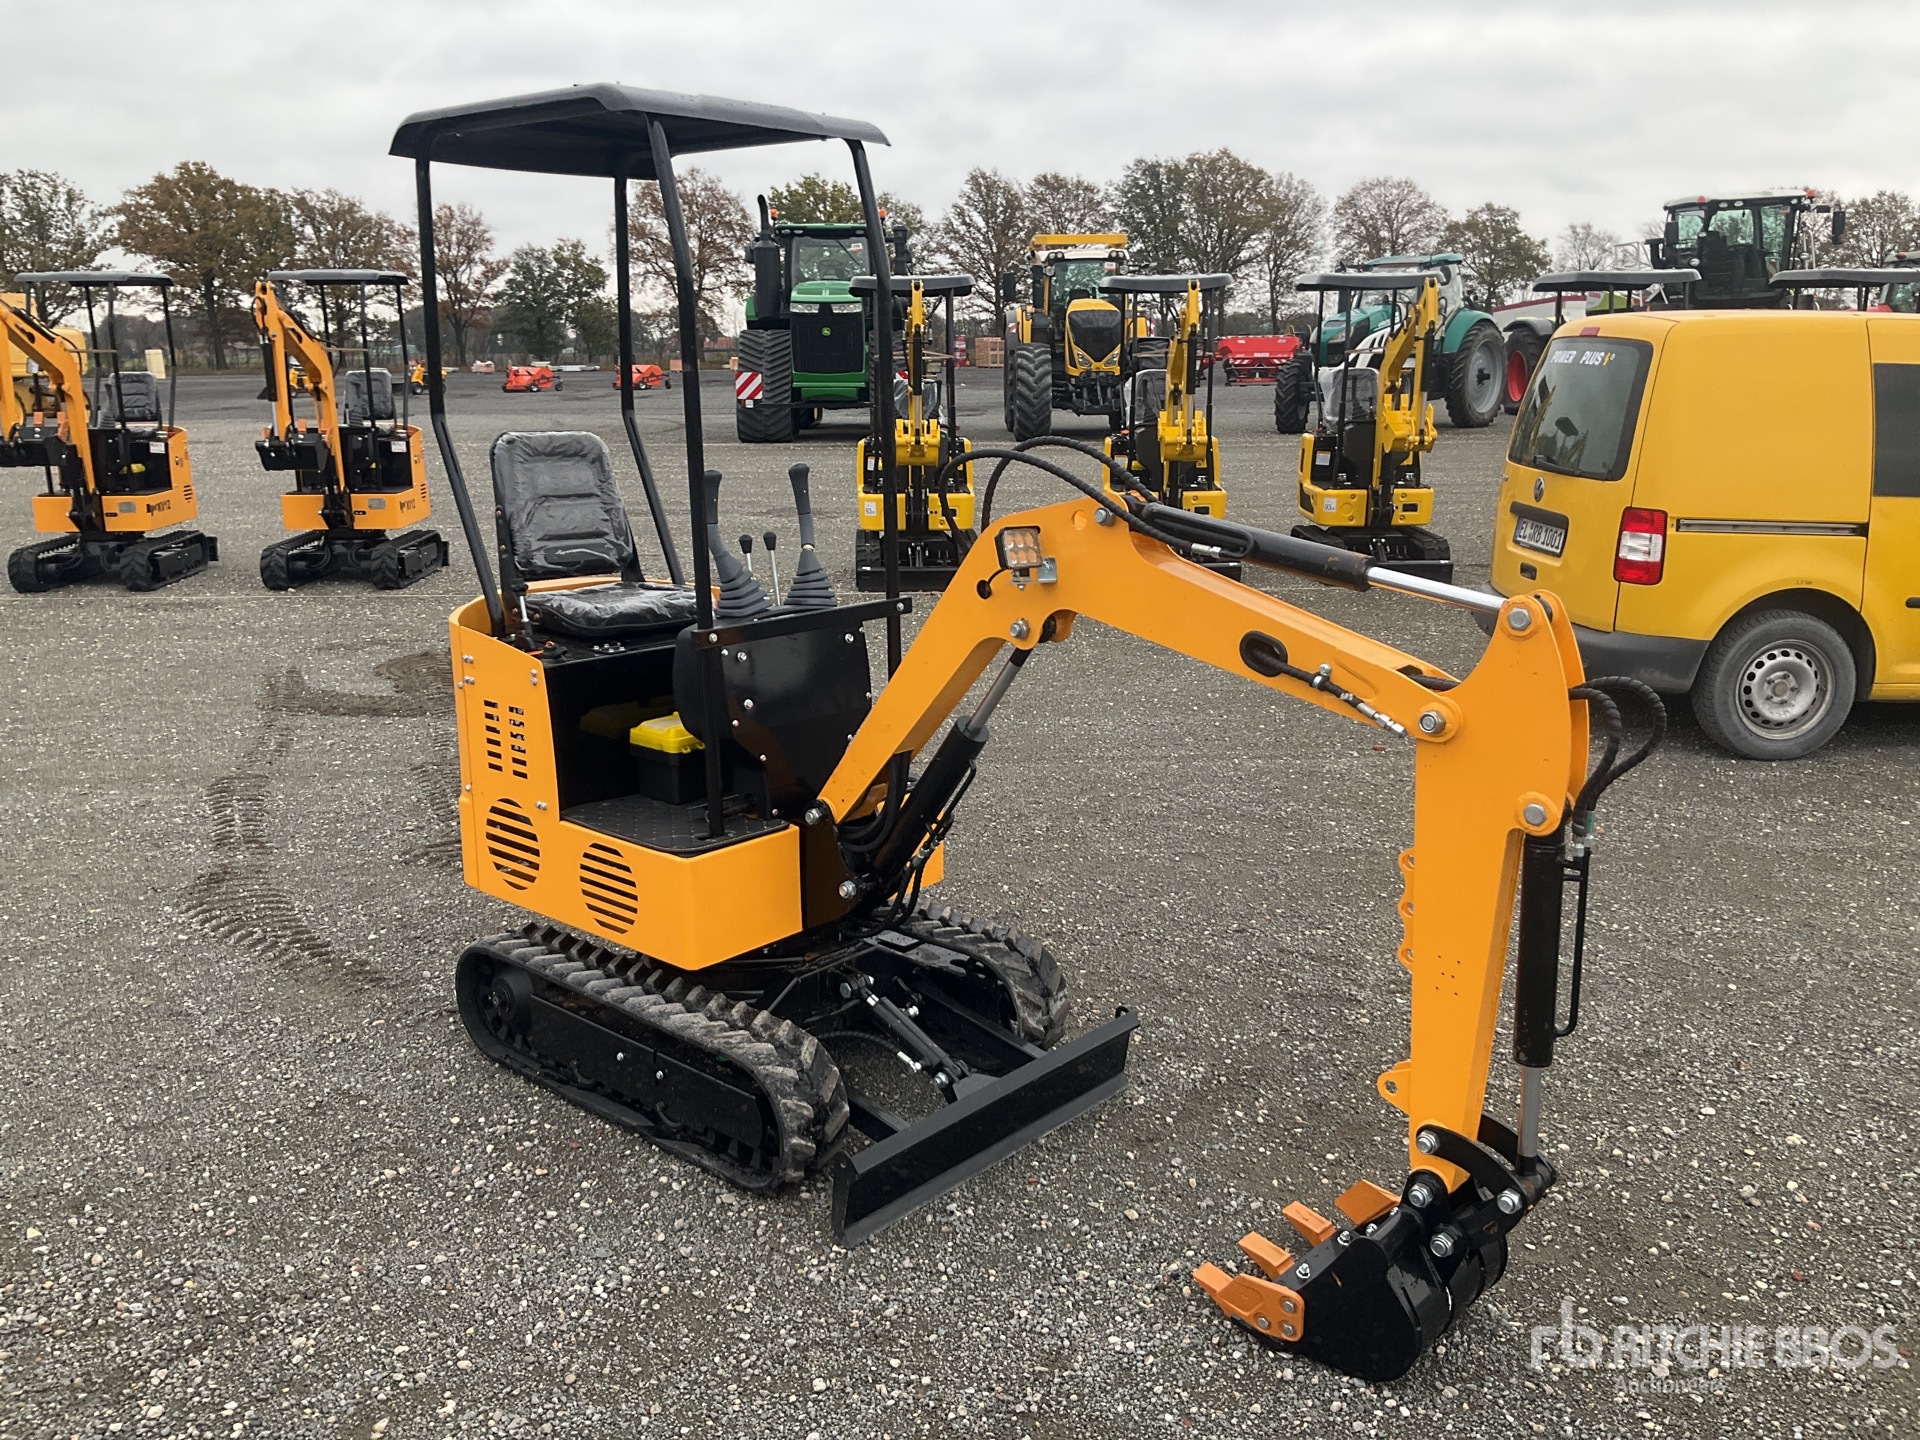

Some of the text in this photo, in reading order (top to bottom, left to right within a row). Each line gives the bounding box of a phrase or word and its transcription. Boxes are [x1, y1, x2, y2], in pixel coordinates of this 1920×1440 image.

[1550, 350, 1605, 365] POWER PLUS
[1519, 520, 1563, 550] EL RB 1001
